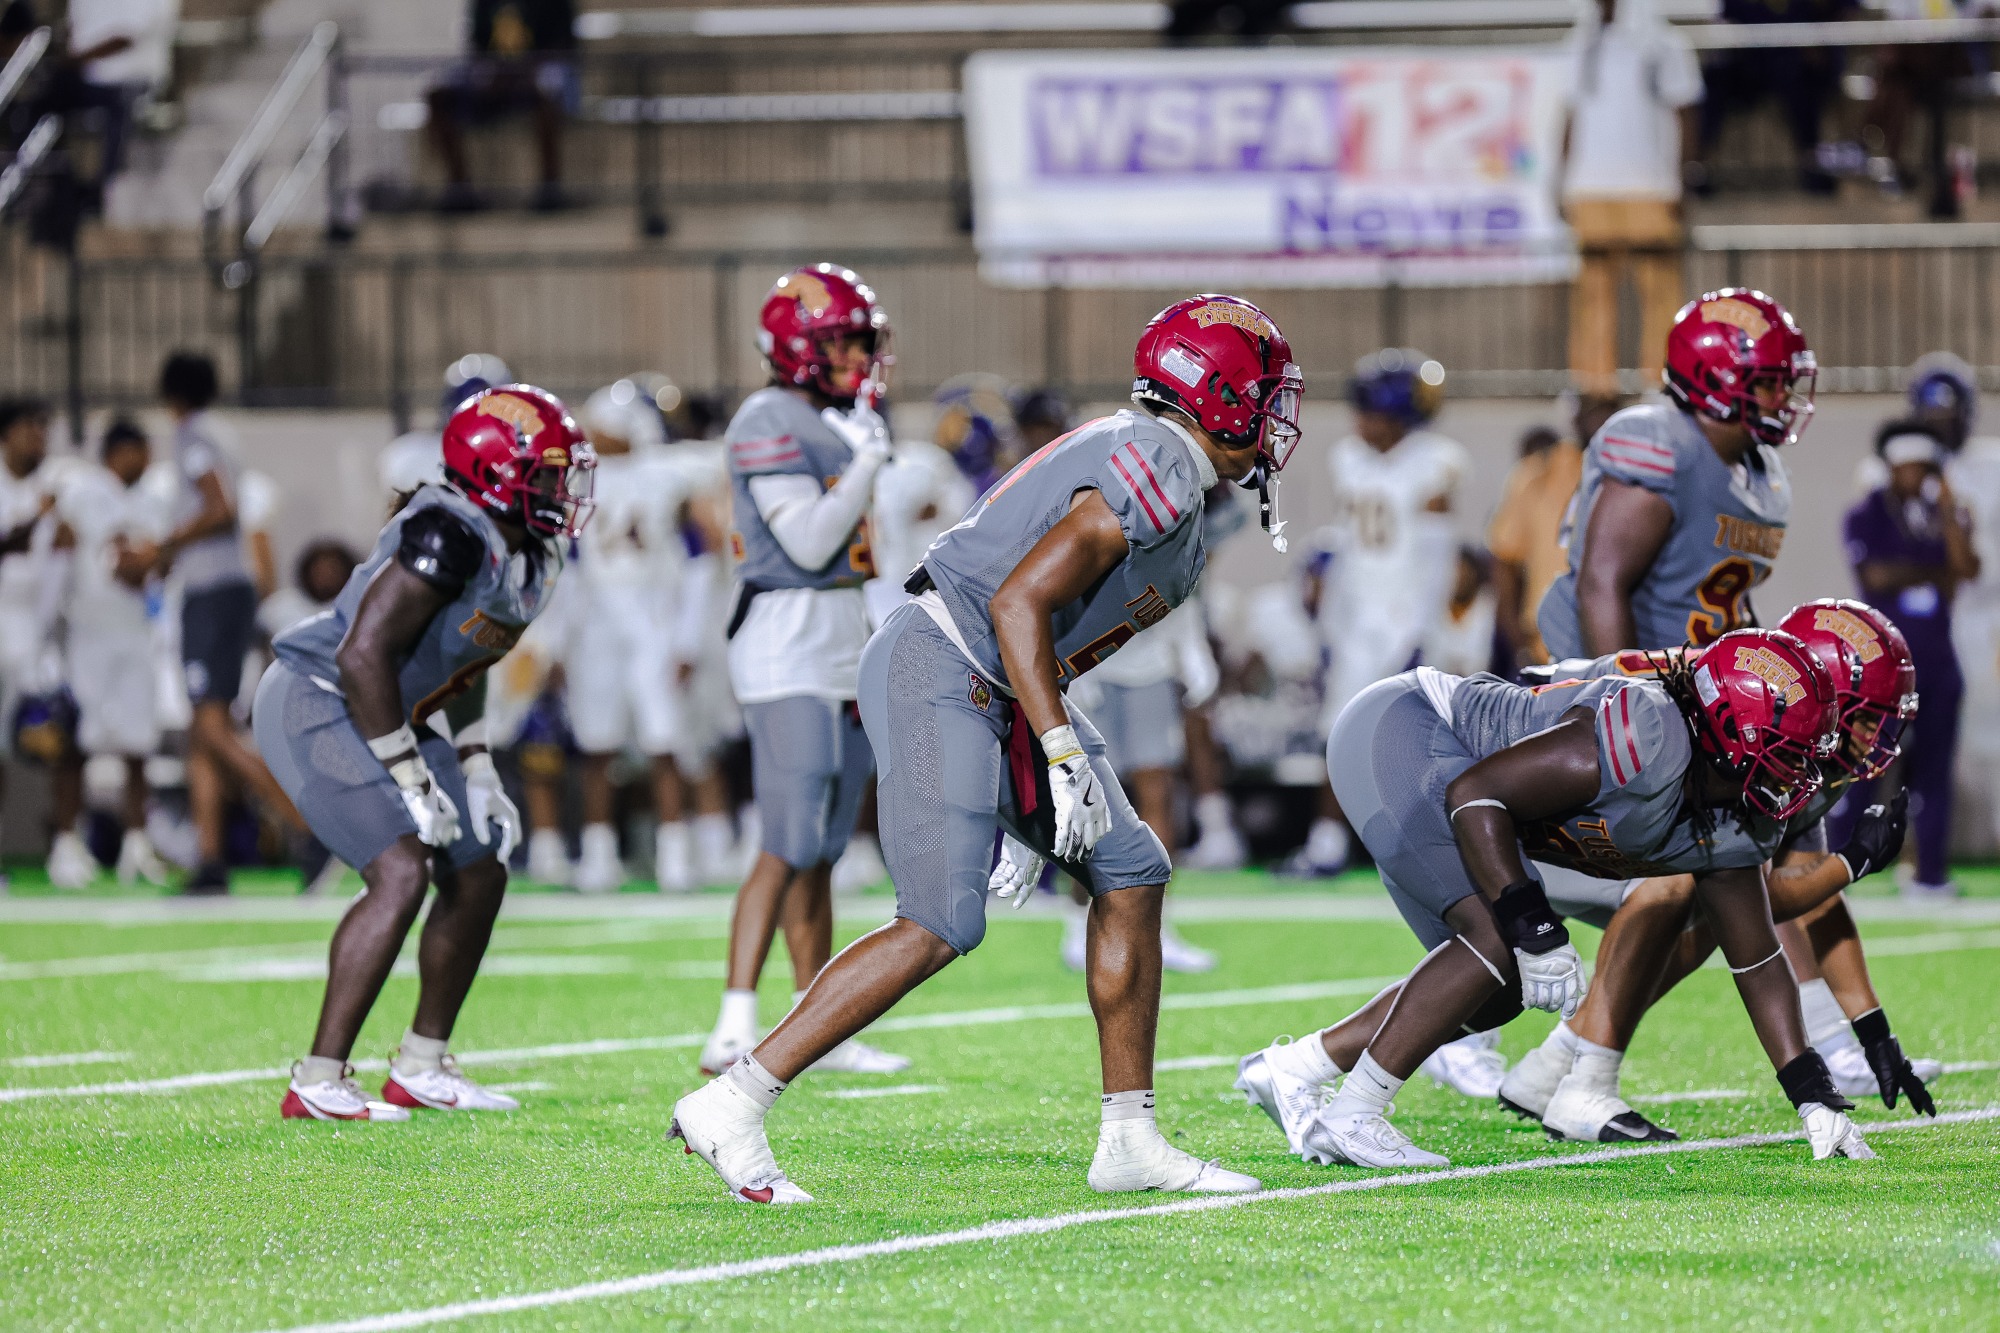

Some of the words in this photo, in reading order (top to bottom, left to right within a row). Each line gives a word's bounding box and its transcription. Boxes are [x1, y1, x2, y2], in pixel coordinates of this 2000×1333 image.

[1037, 84, 1338, 172] WSFA
[1345, 68, 1514, 182] 12
[1188, 305, 1272, 341] TIGERS
[1813, 609, 1884, 665] TIGERS
[1733, 646, 1808, 707] TIGERS
